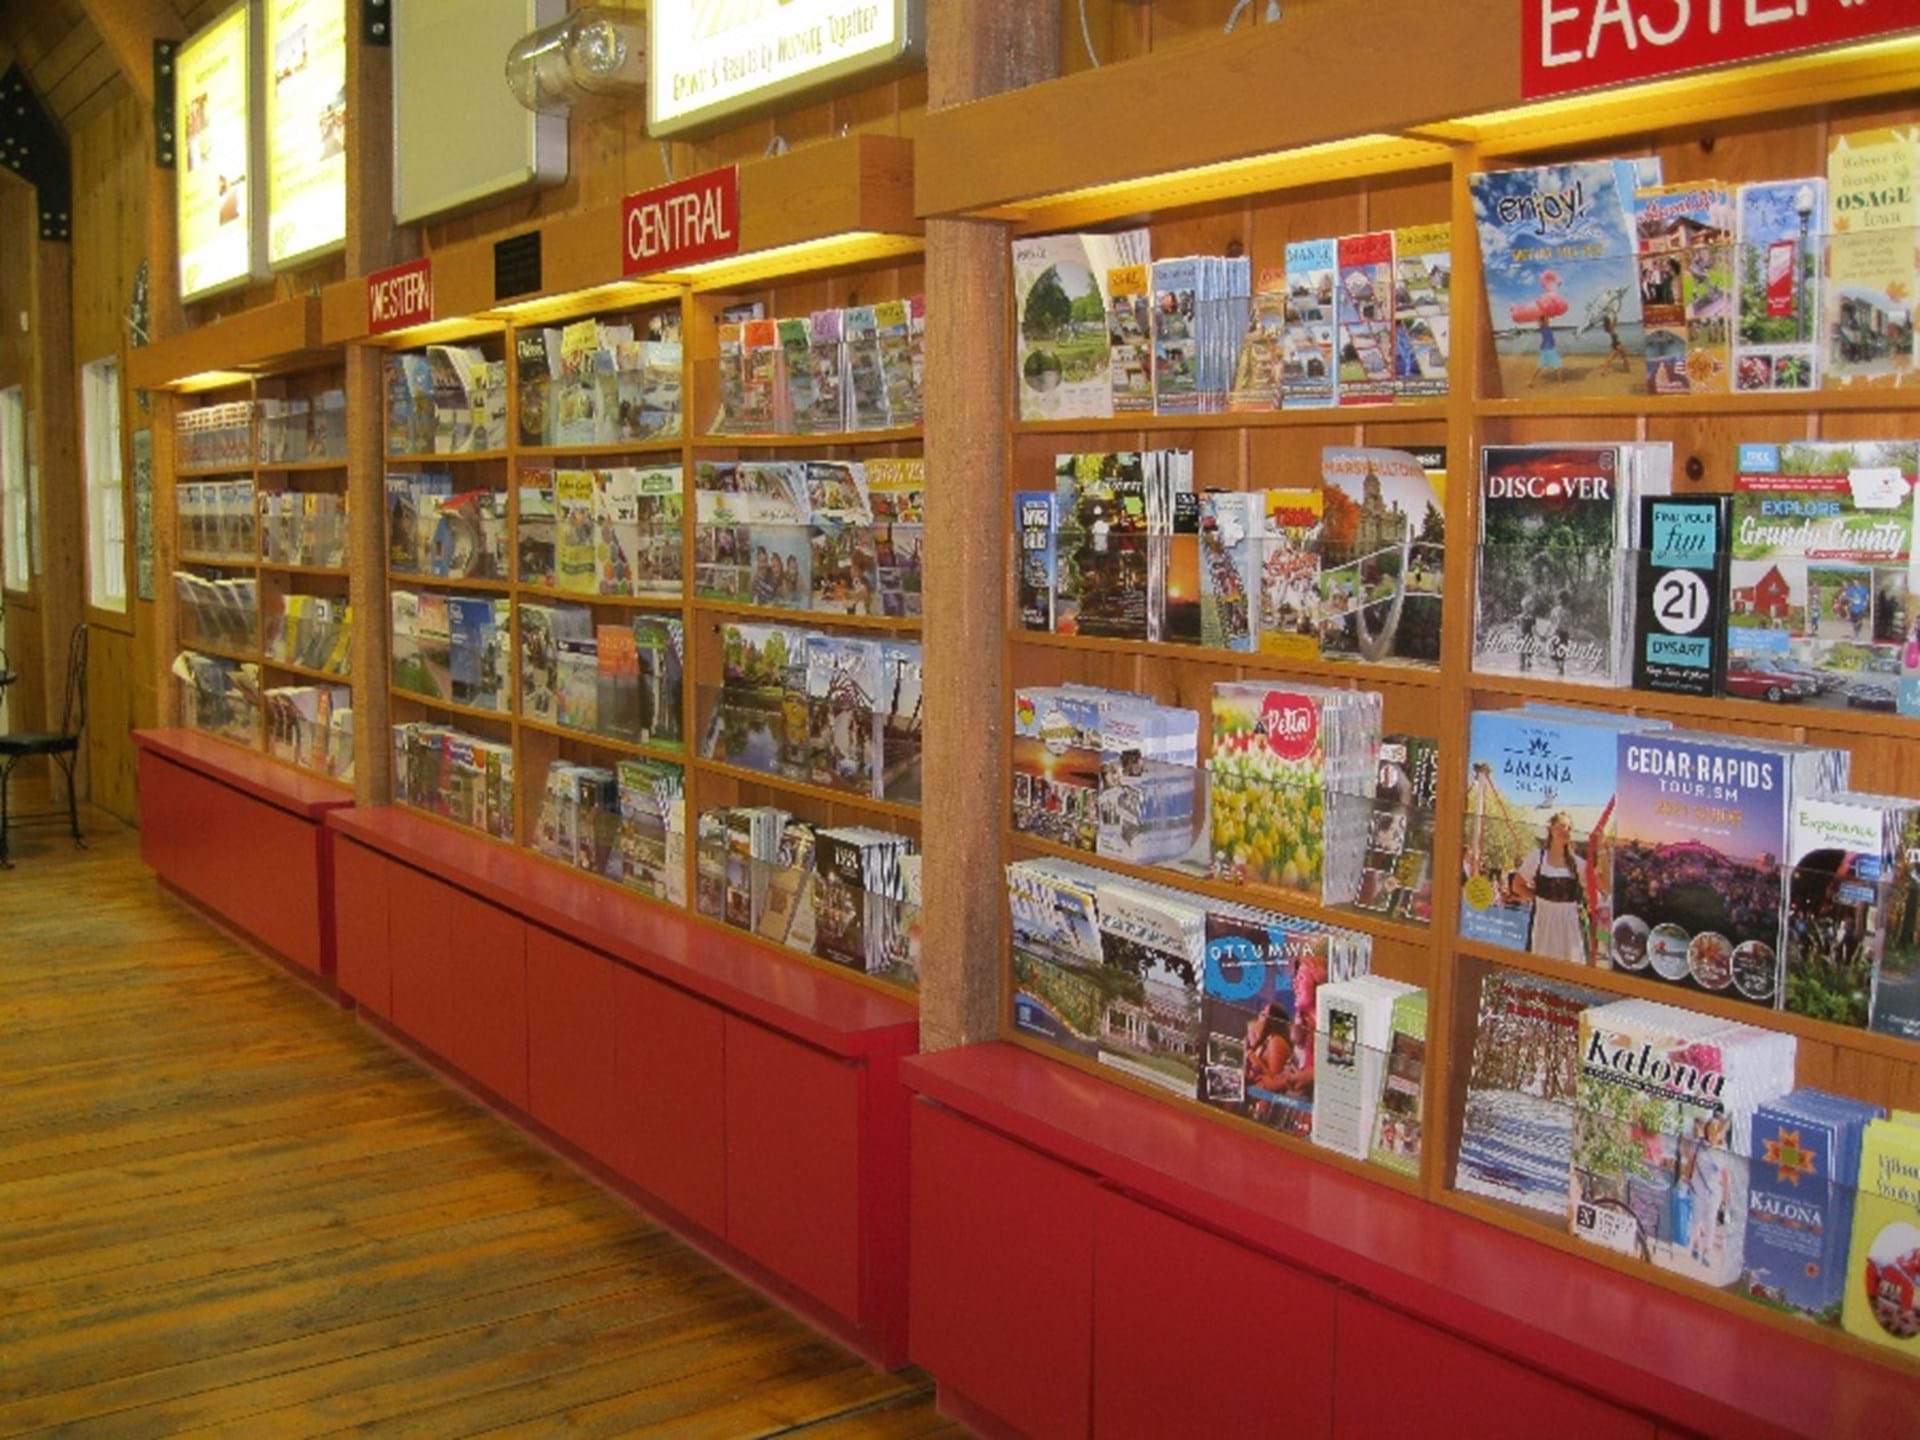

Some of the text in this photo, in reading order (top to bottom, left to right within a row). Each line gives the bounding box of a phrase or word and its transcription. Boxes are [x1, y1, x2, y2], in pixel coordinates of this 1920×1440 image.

[1498, 180, 1585, 235] enjoy!
[1836, 186, 1912, 211] OSAGE
[628, 186, 731, 260] CENTRAL
[370, 268, 430, 323] WESTERN
[1655, 511, 1713, 525] FIND YOUR
[1761, 500, 1841, 517] EXPLORE
[1657, 523, 1706, 560] fun
[1740, 516, 1907, 559] Grundy County
[1661, 580, 1697, 619] 21
[1546, 635, 1603, 672] County
[1652, 640, 1705, 657] DYSART
[1268, 707, 1312, 738] Pella
[1503, 759, 1573, 783] AMANA
[1626, 746, 1774, 790] CEDAR RAPIDS
[1659, 778, 1739, 803] TOURISM
[1210, 942, 1315, 961] OTTUMWA
[1586, 1029, 1727, 1097] Kalona
[1750, 1189, 1823, 1228] KALONA
